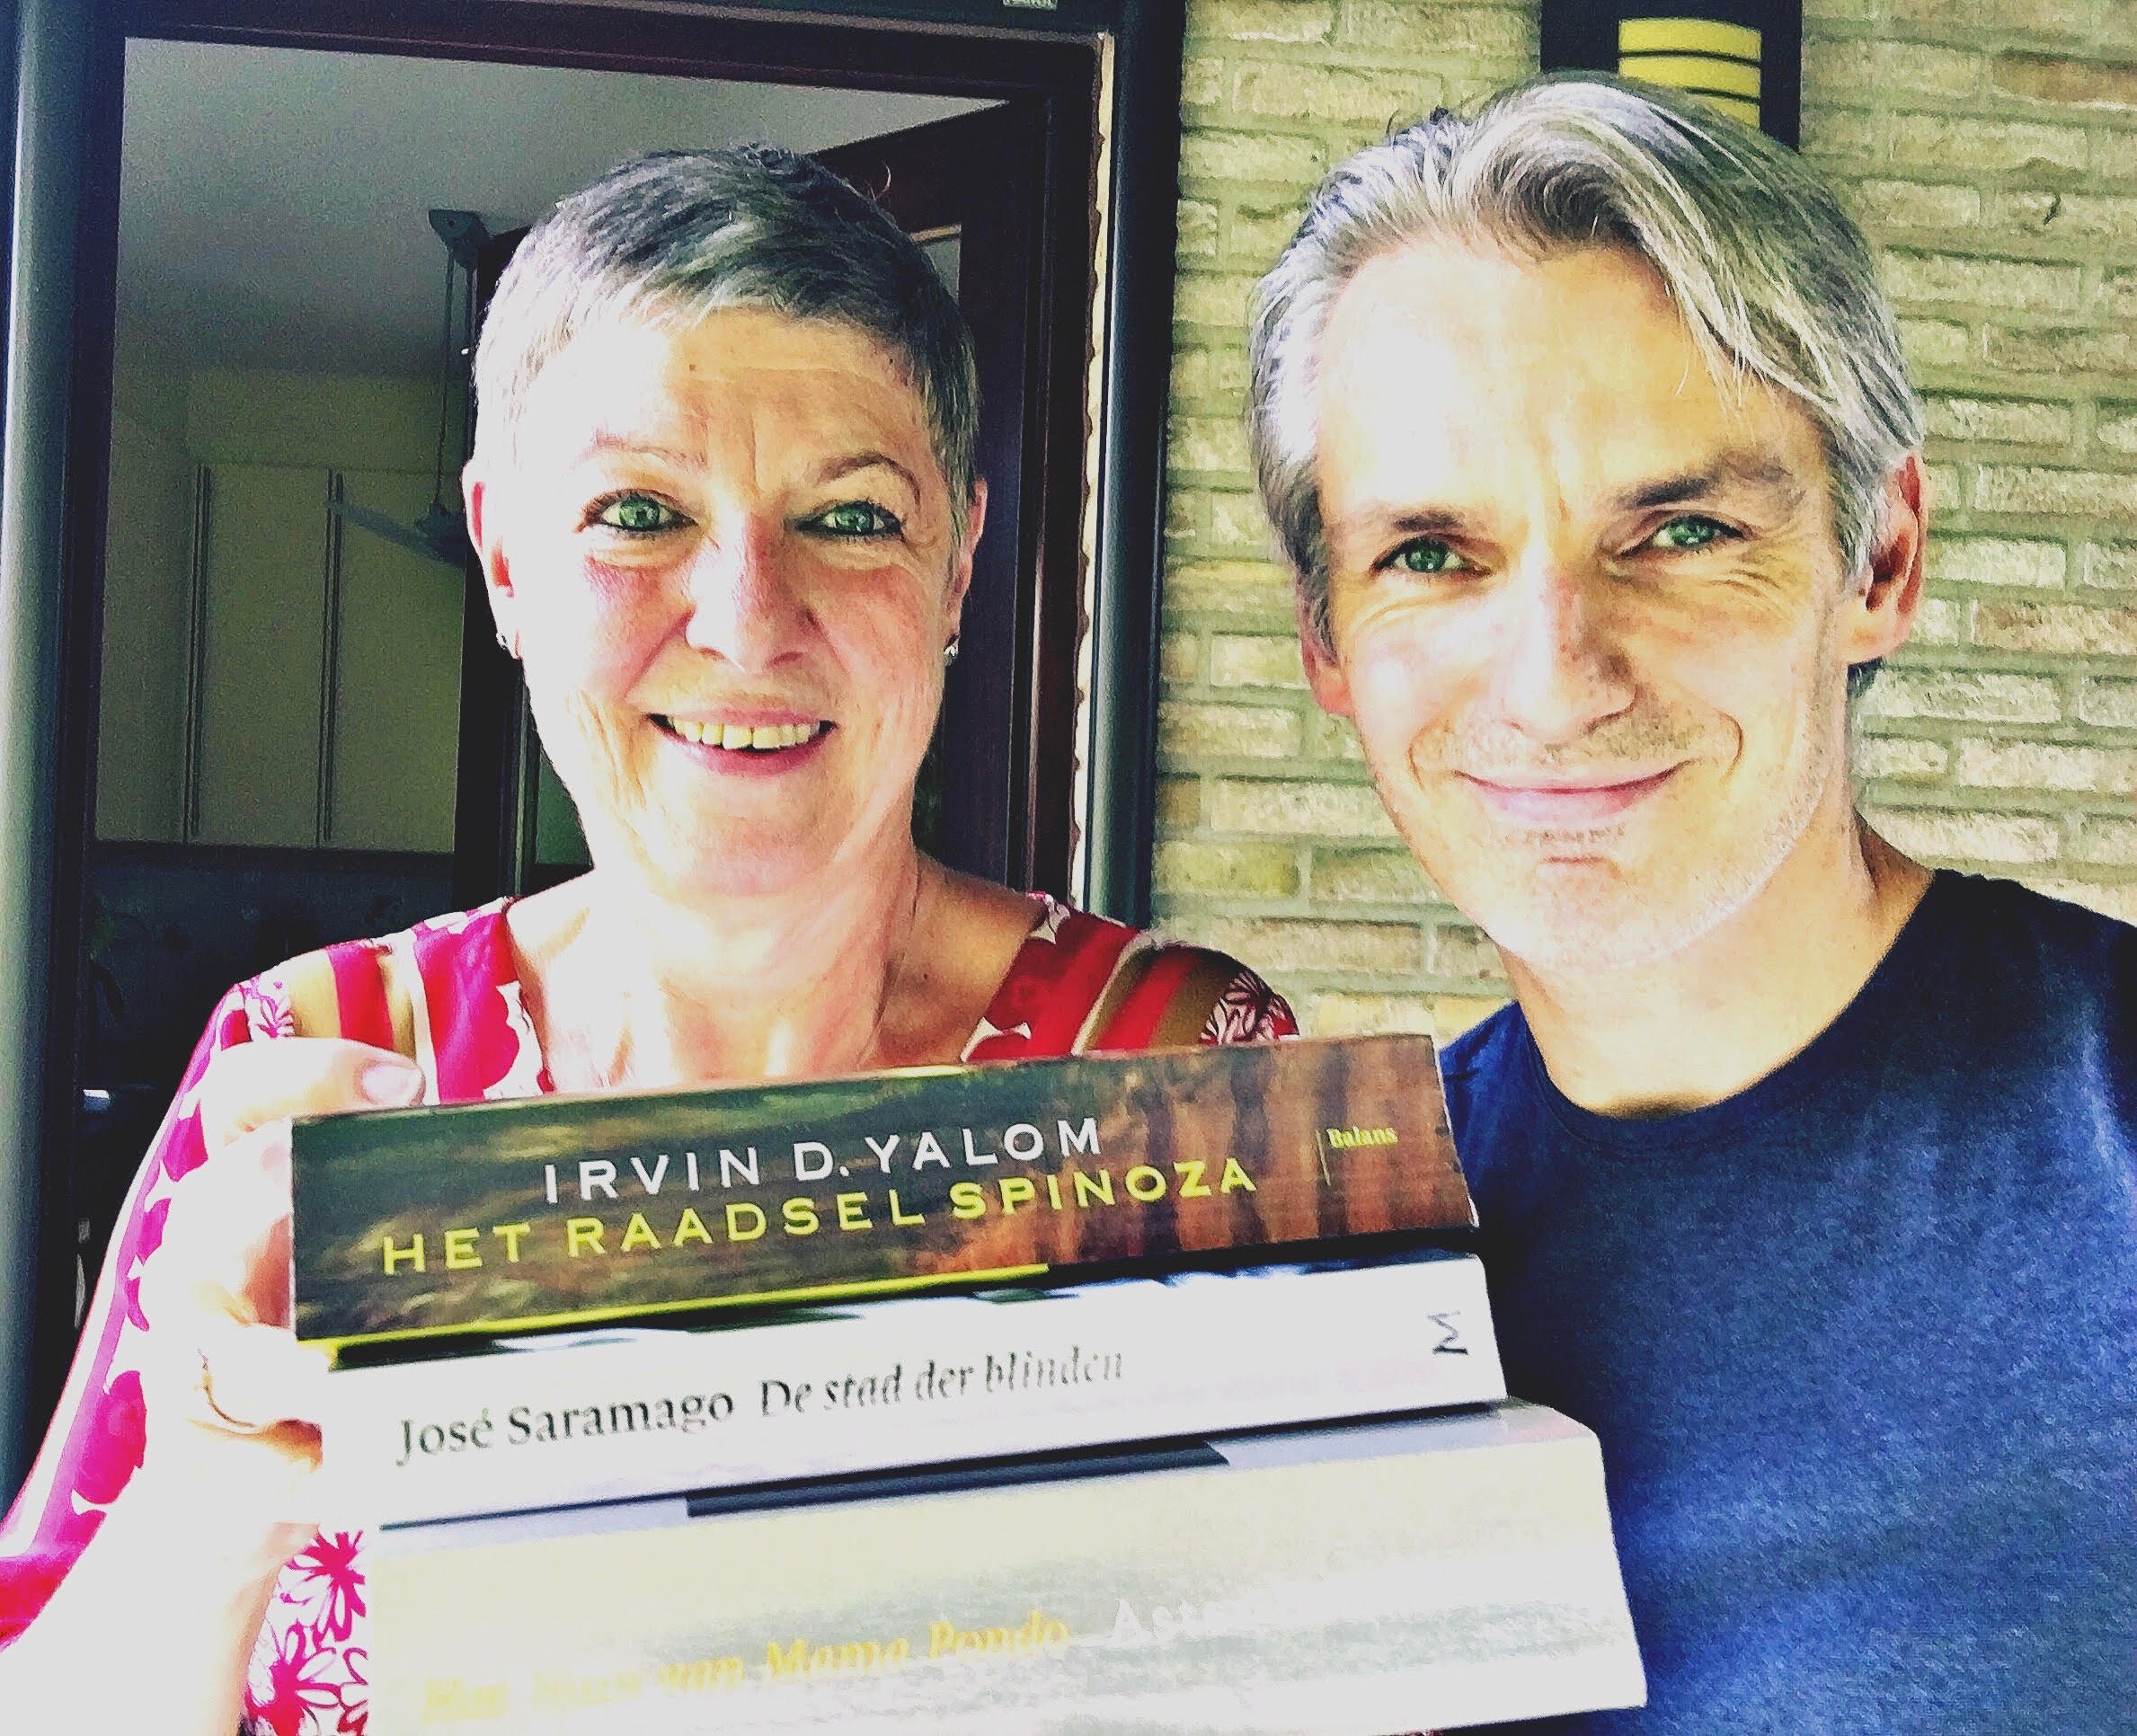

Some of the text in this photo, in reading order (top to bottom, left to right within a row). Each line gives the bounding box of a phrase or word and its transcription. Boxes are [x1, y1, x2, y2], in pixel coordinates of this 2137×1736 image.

[544, 1117, 1102, 1204] IRVIN D. YALOM
[1326, 1125, 1398, 1148] Balans
[382, 1157, 1257, 1276] HET RAADSEL SPINOZA
[396, 1342, 1122, 1467] José Saramago De stad der blinden
[767, 1637, 910, 1678] Mama
[928, 1608, 1070, 1661] Pondo
